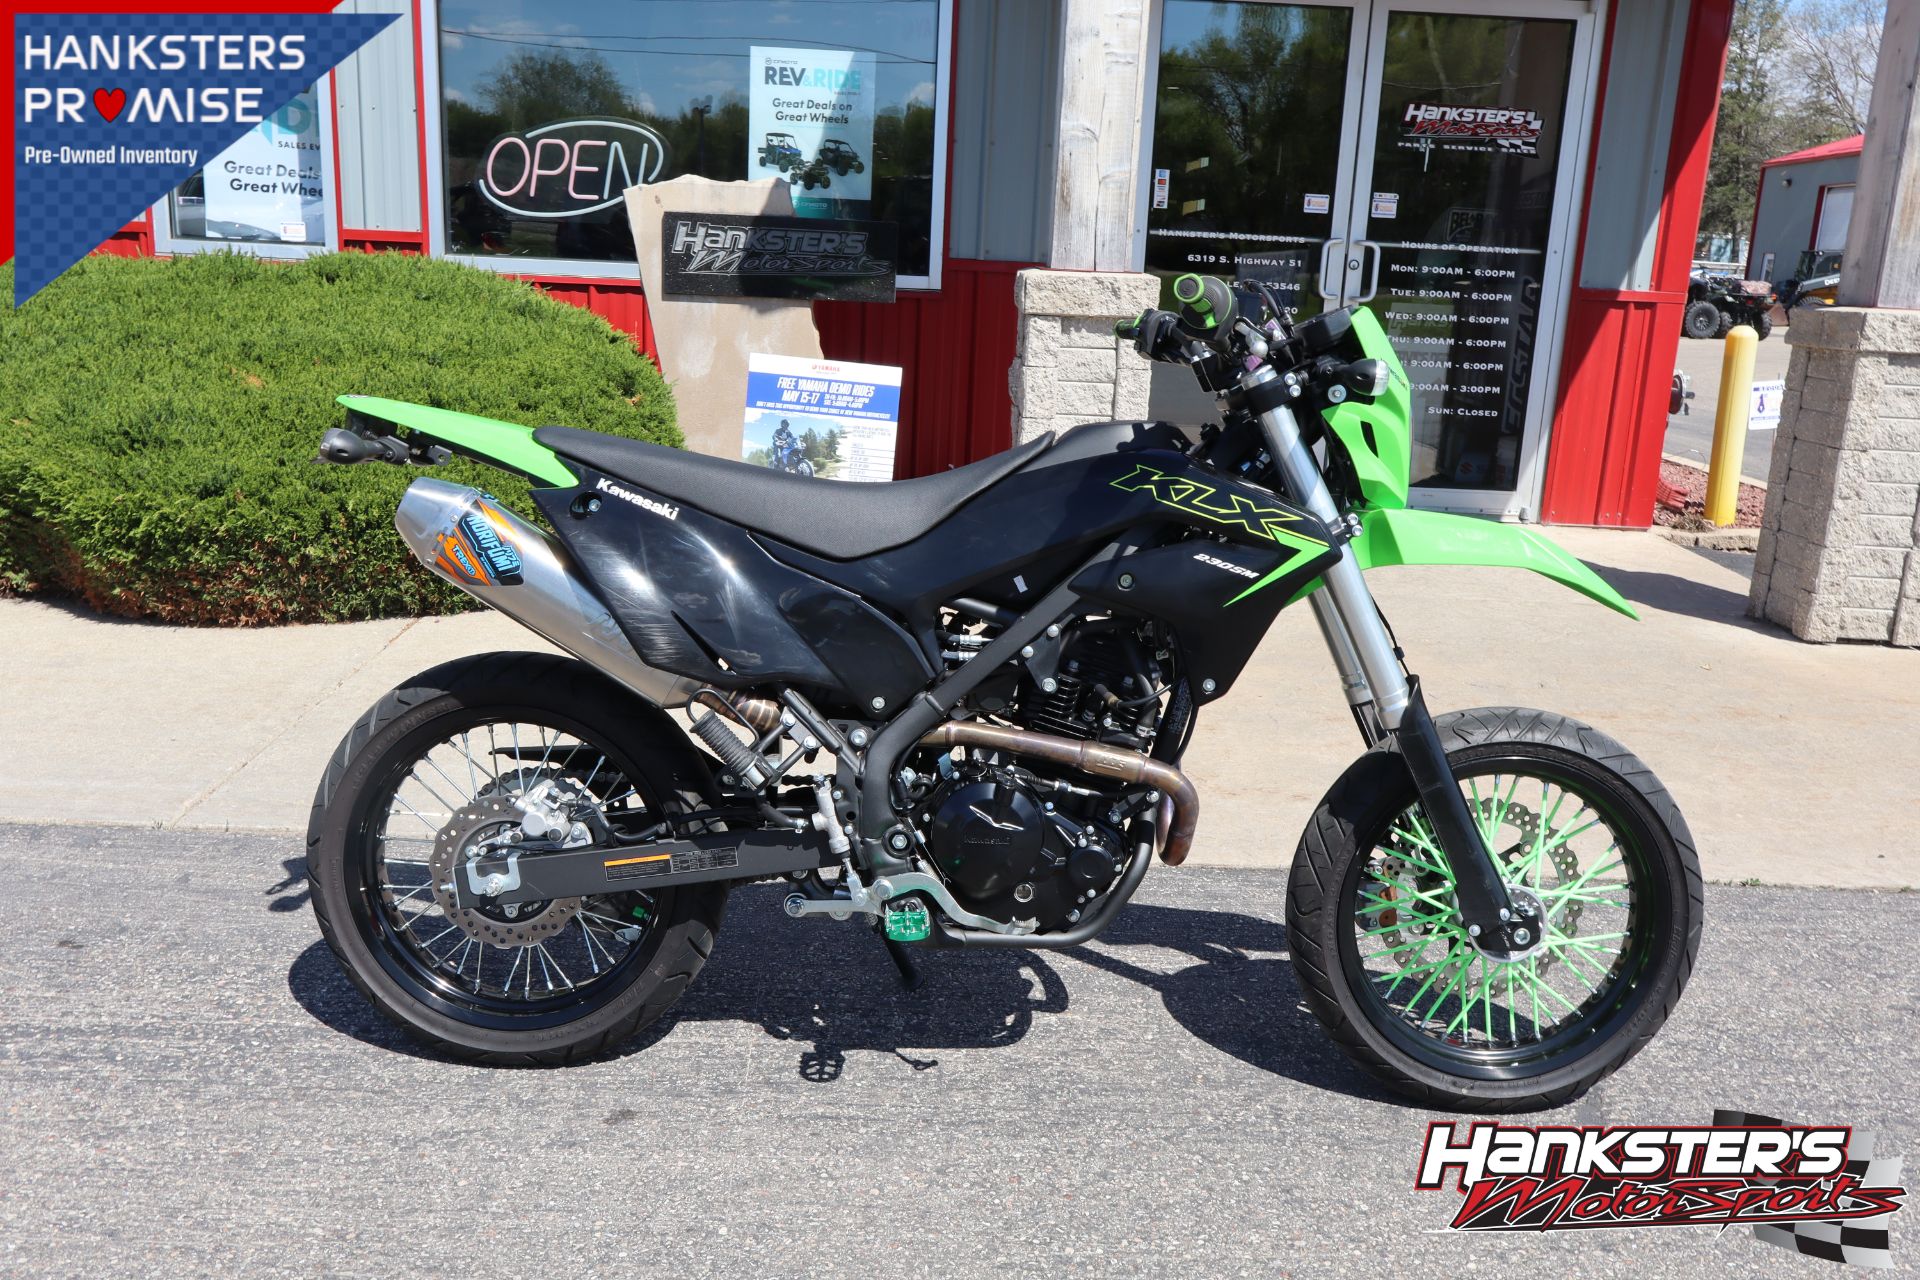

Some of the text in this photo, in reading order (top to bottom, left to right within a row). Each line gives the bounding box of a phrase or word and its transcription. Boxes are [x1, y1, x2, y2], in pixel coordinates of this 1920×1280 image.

[772, 98, 804, 108] Great
[806, 100, 836, 111] Deals
[775, 111, 849, 124] Great Wheels
[278, 141, 306, 149] SALES
[1443, 144, 1493, 152] SERVICE
[224, 161, 321, 179] Great Deals
[486, 137, 649, 200] OPEN
[230, 178, 278, 193] Great
[1159, 228, 1305, 244] HANKSTER'S MOTORSPORTS
[1401, 241, 1438, 250] HOURS
[1458, 244, 1519, 255] OPERATION
[1187, 254, 1302, 267] 6319 S. HIGHWAY 51
[1390, 264, 1418, 273] MON:
[1474, 268, 1515, 278] 6:00PM
[1390, 288, 1415, 297] TUE:
[1419, 289, 1460, 299] 9:00AM
[1471, 292, 1512, 302] 6:00PM
[1385, 311, 1413, 320] WED:
[1416, 313, 1458, 322] 9:00AM
[1468, 315, 1510, 325] 6:00PM
[1413, 336, 1455, 346] 9:00AM
[1466, 339, 1507, 348] 6:00PM
[1410, 360, 1452, 369] 9:00AM
[1463, 362, 1504, 371] 6:00PM
[777, 376, 875, 397] FREE YAMAHA DEMO RIDES
[1459, 385, 1501, 394] 3:00PM
[782, 389, 820, 404] MAY 15-17
[1428, 406, 1498, 417] SUN: CLOSED
[595, 477, 680, 521] Kawasaki
[1109, 464, 1304, 541] KLX
[466, 513, 513, 572] NORIFUMI
[1193, 553, 1260, 579] 230SM
